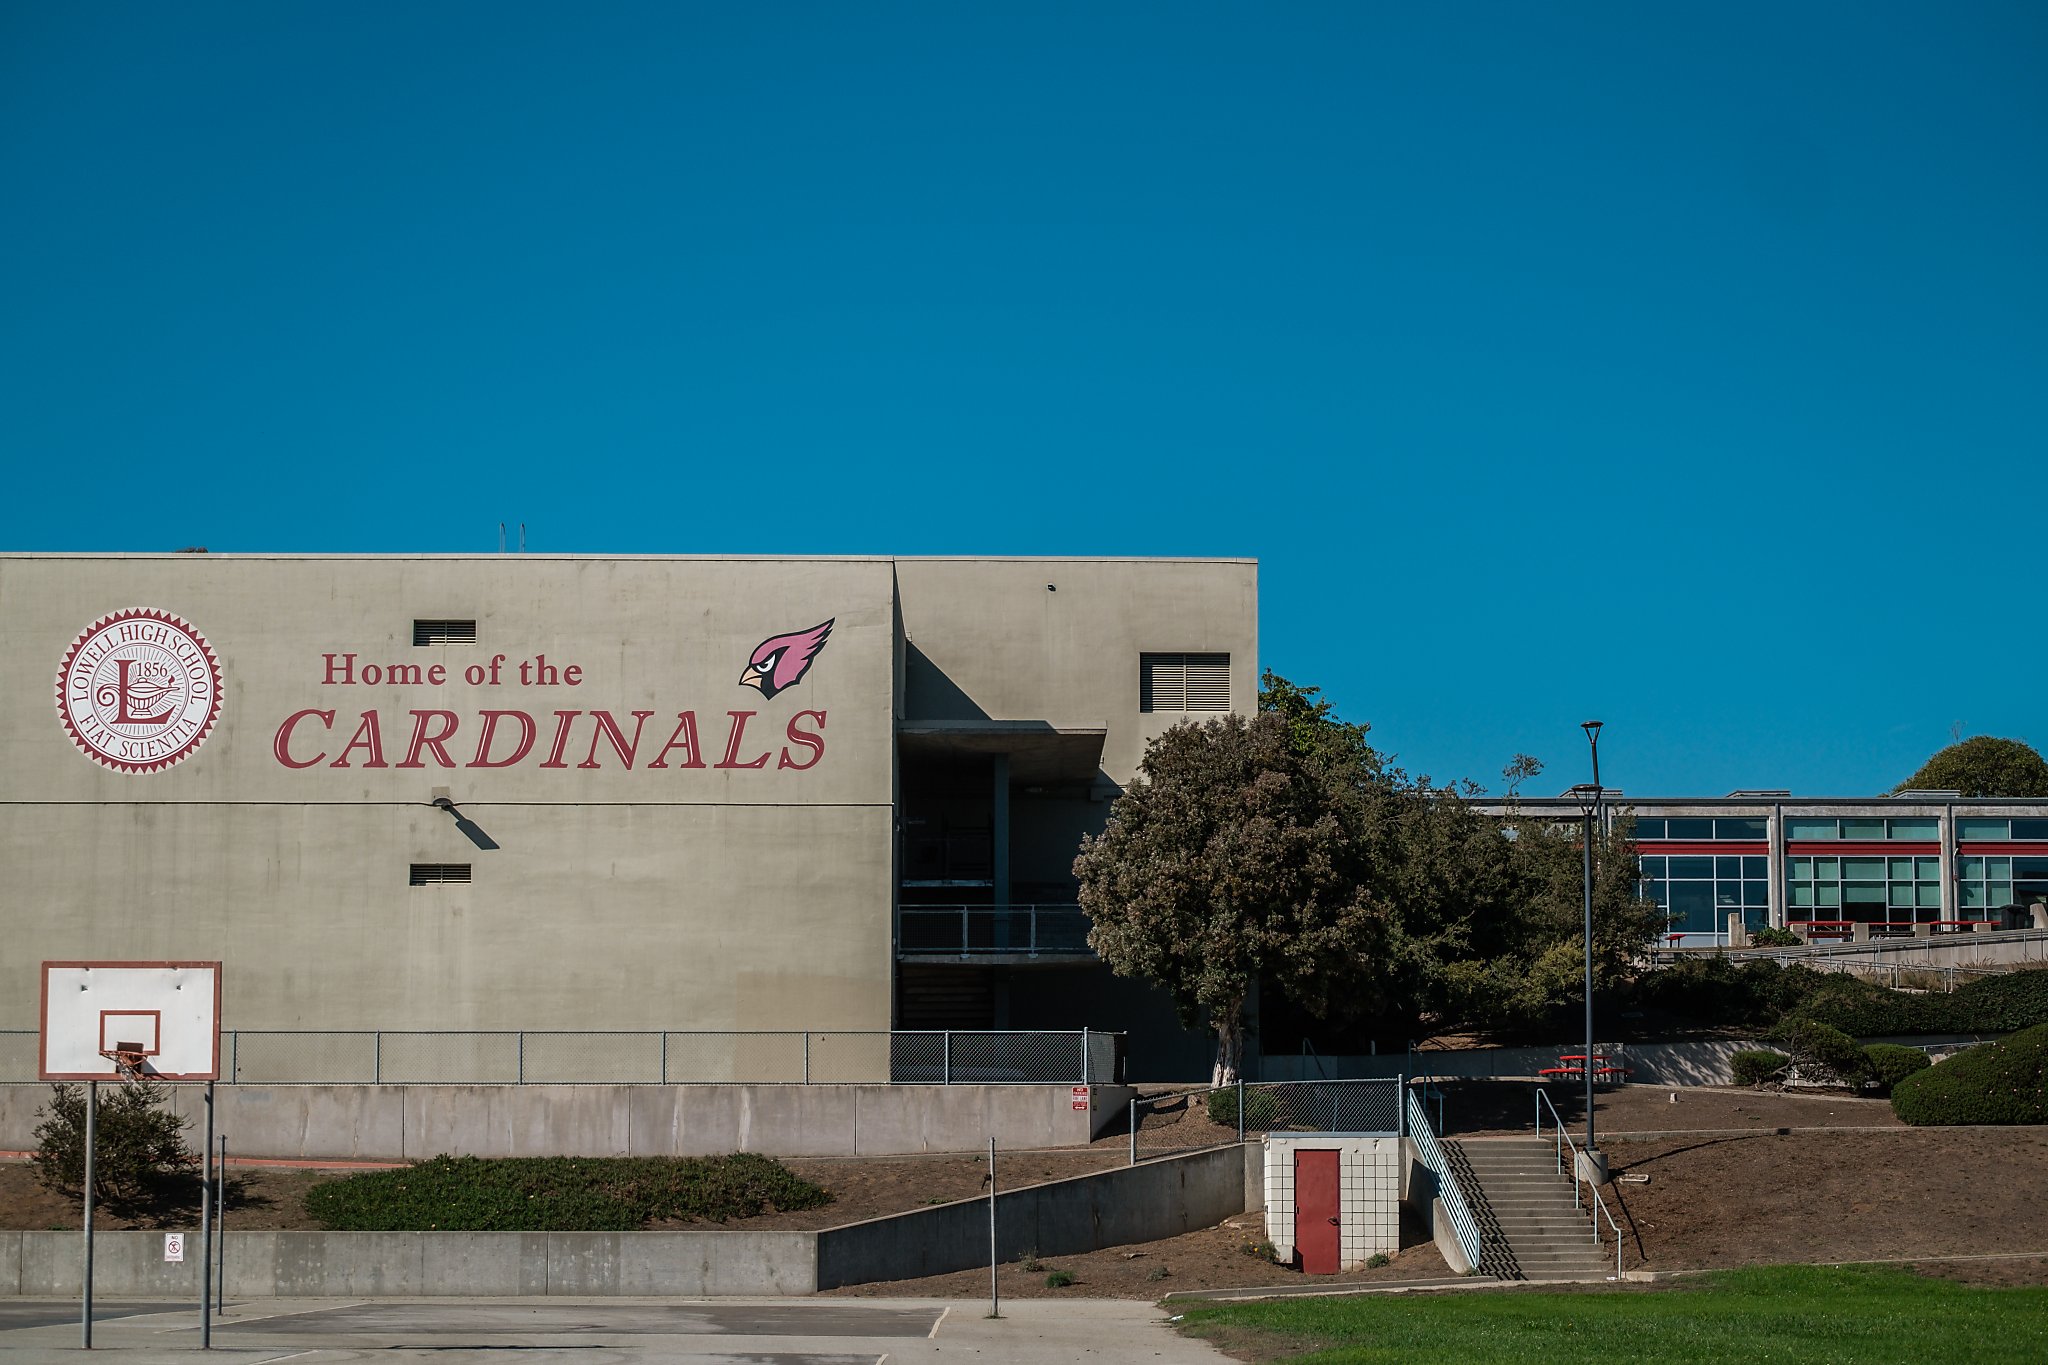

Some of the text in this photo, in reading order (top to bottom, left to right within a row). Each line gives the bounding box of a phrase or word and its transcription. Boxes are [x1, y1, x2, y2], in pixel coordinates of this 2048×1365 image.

[73, 624, 208, 705] LOWELL HIGH SCHOOL
[137, 662, 168, 678] 1856
[321, 653, 584, 686] Home of the
[110, 659, 176, 725] L
[79, 714, 198, 759] FIAT SCIENTIA
[273, 709, 828, 771] CARDINALS
